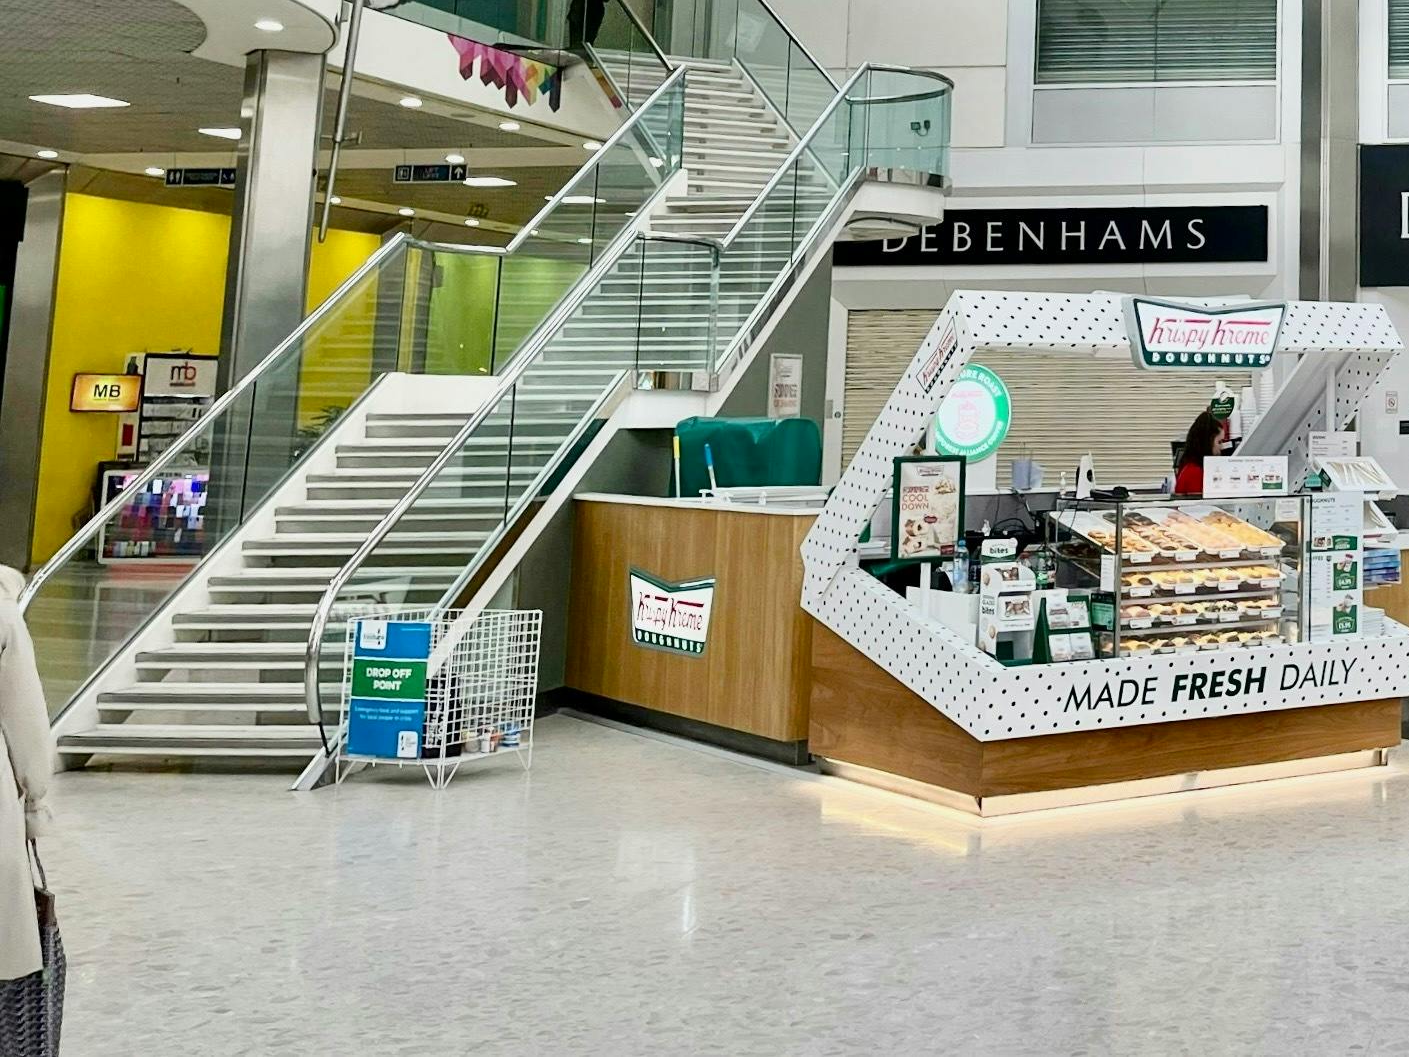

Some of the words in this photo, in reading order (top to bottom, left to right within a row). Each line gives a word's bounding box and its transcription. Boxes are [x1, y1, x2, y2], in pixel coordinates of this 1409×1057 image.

[93, 384, 122, 398] MB
[902, 493, 929, 503] COOL
[901, 502, 930, 511] DOWN
[989, 546, 1009, 554] bites
[366, 667, 392, 679] DROP
[392, 668, 413, 679] OFF
[373, 680, 402, 691] POINT
[1063, 676, 1159, 713] MADE
[1170, 666, 1267, 703] FRESH
[1279, 657, 1358, 691] DAILY
